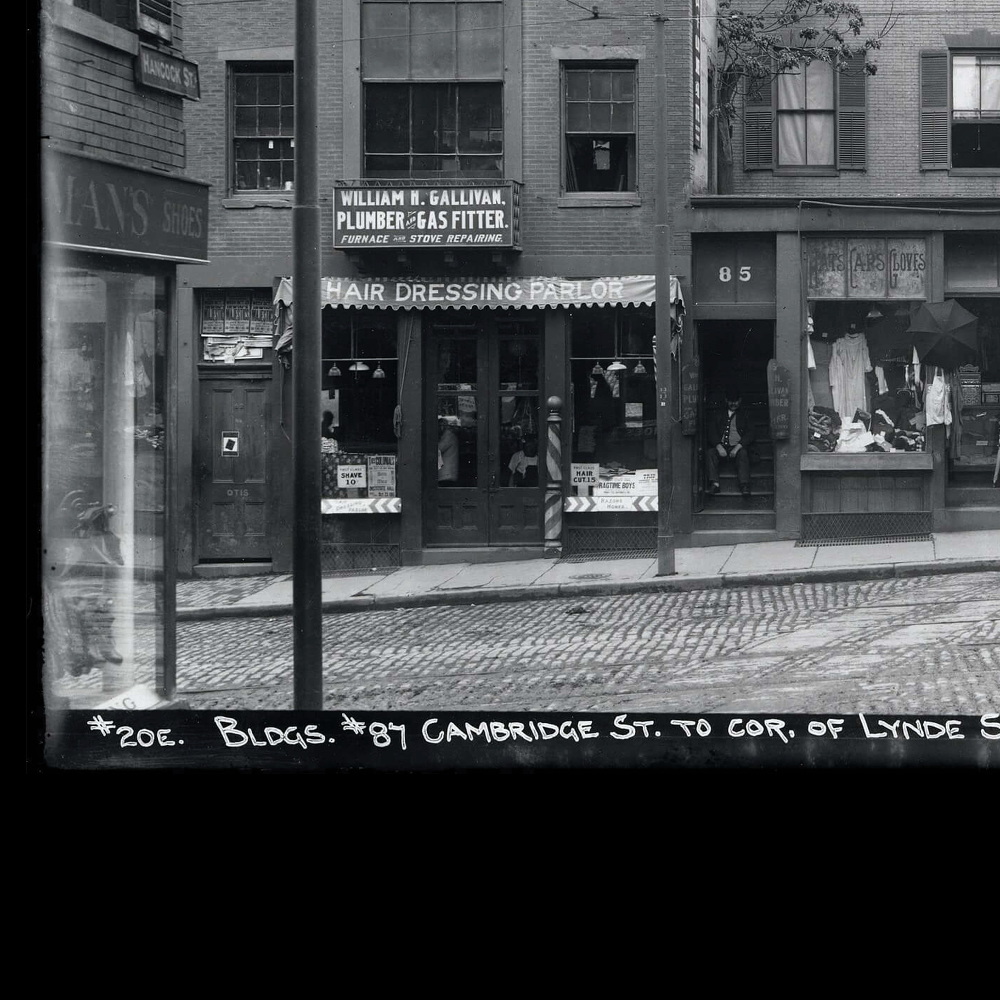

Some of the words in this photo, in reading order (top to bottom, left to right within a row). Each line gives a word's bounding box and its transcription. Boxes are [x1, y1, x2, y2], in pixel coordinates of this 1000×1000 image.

[142, 52, 182, 84] HANCOCK
[340, 189, 405, 206] WILLIAM
[410, 189, 425, 206] H.
[429, 189, 506, 207] GALLIVAN,
[162, 200, 203, 238] SHOES
[337, 210, 405, 230] PLUMBER
[416, 210, 448, 230] GAS
[451, 209, 509, 229] FITTER.
[340, 234, 390, 244] FURNACE
[409, 234, 443, 243] STOVE
[446, 234, 503, 243] REPAIRING.
[849, 247, 885, 289] CAPS
[889, 248, 926, 289] GLOVES
[326, 280, 385, 301] HAIR
[395, 280, 523, 302] DRESSING
[529, 280, 624, 301] PARLOR
[226, 488, 249, 497] OTIS
